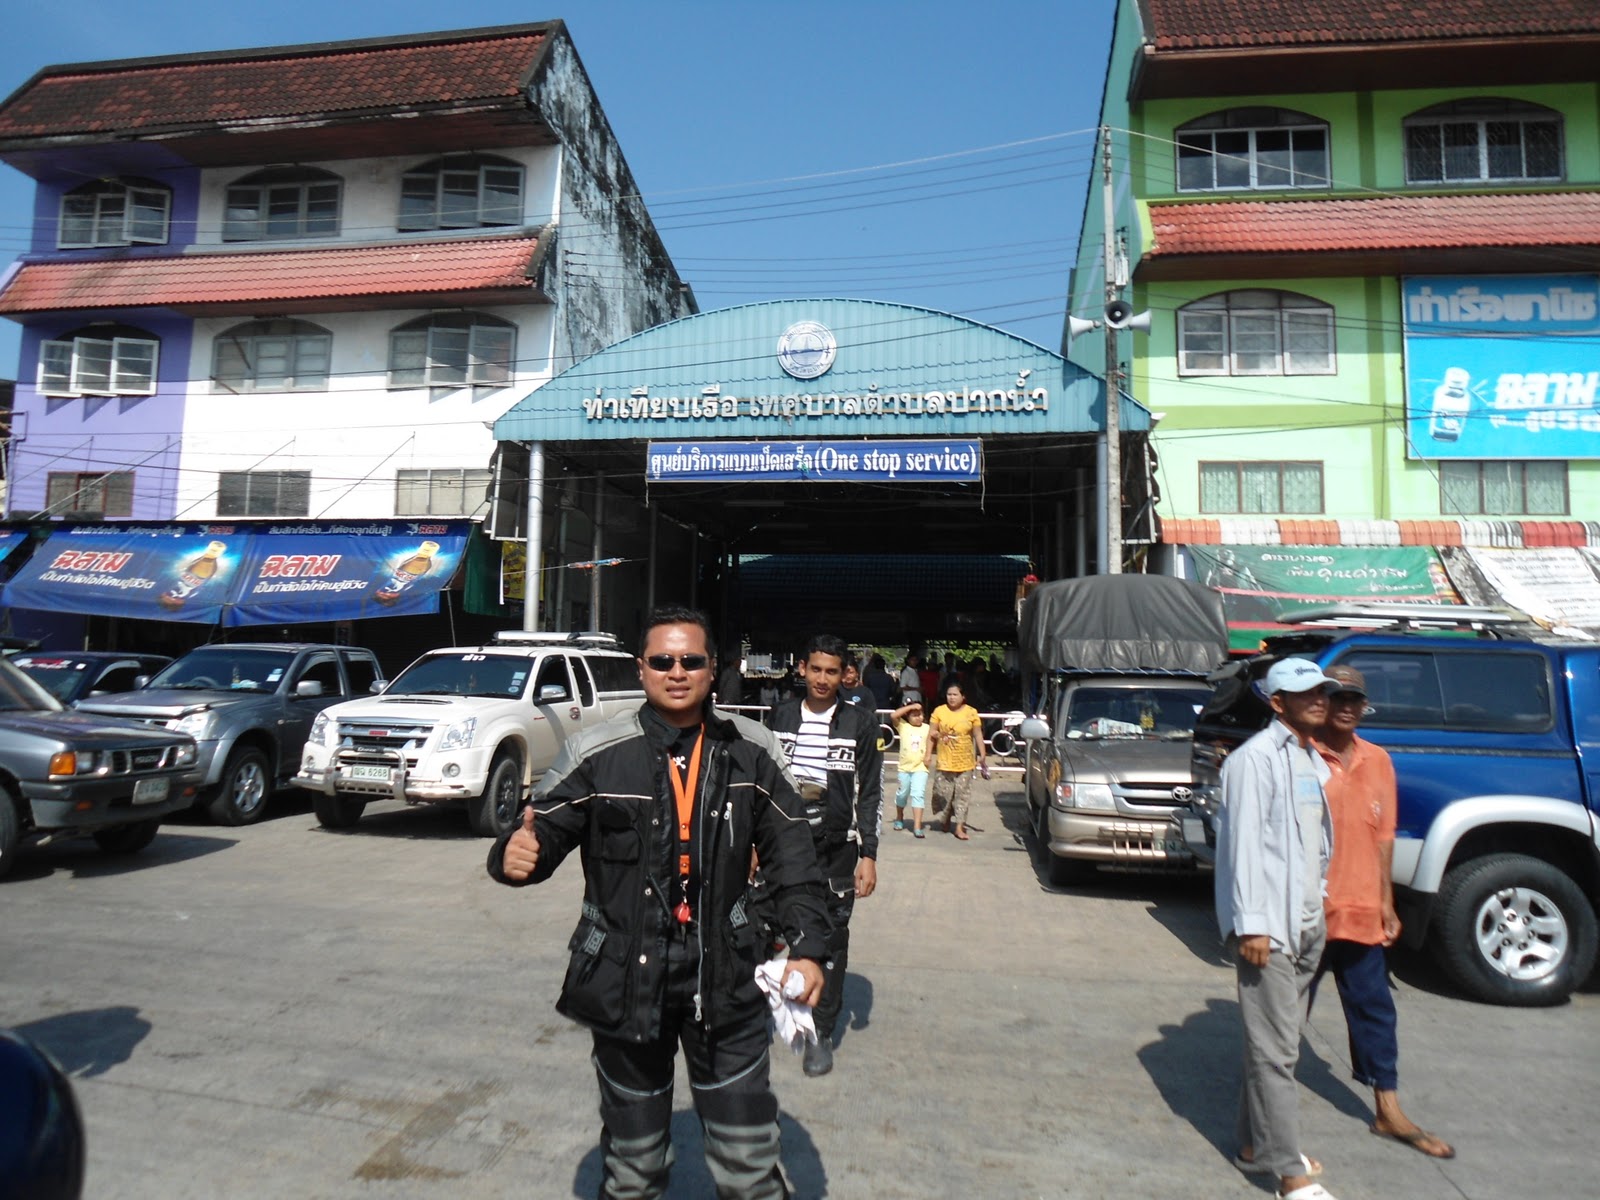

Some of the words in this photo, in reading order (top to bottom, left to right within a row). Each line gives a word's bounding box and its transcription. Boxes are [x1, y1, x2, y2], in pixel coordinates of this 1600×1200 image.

[582, 384, 738, 419] ท่าเทียบเรือ
[750, 368, 1048, 417] เทศบาลตำบลปากน้ำ
[815, 446, 858, 476] (One
[863, 449, 901, 477] stop
[906, 445, 977, 475] service)
[50, 550, 134, 572] ฉลาม
[259, 555, 342, 577] ฉลาม
